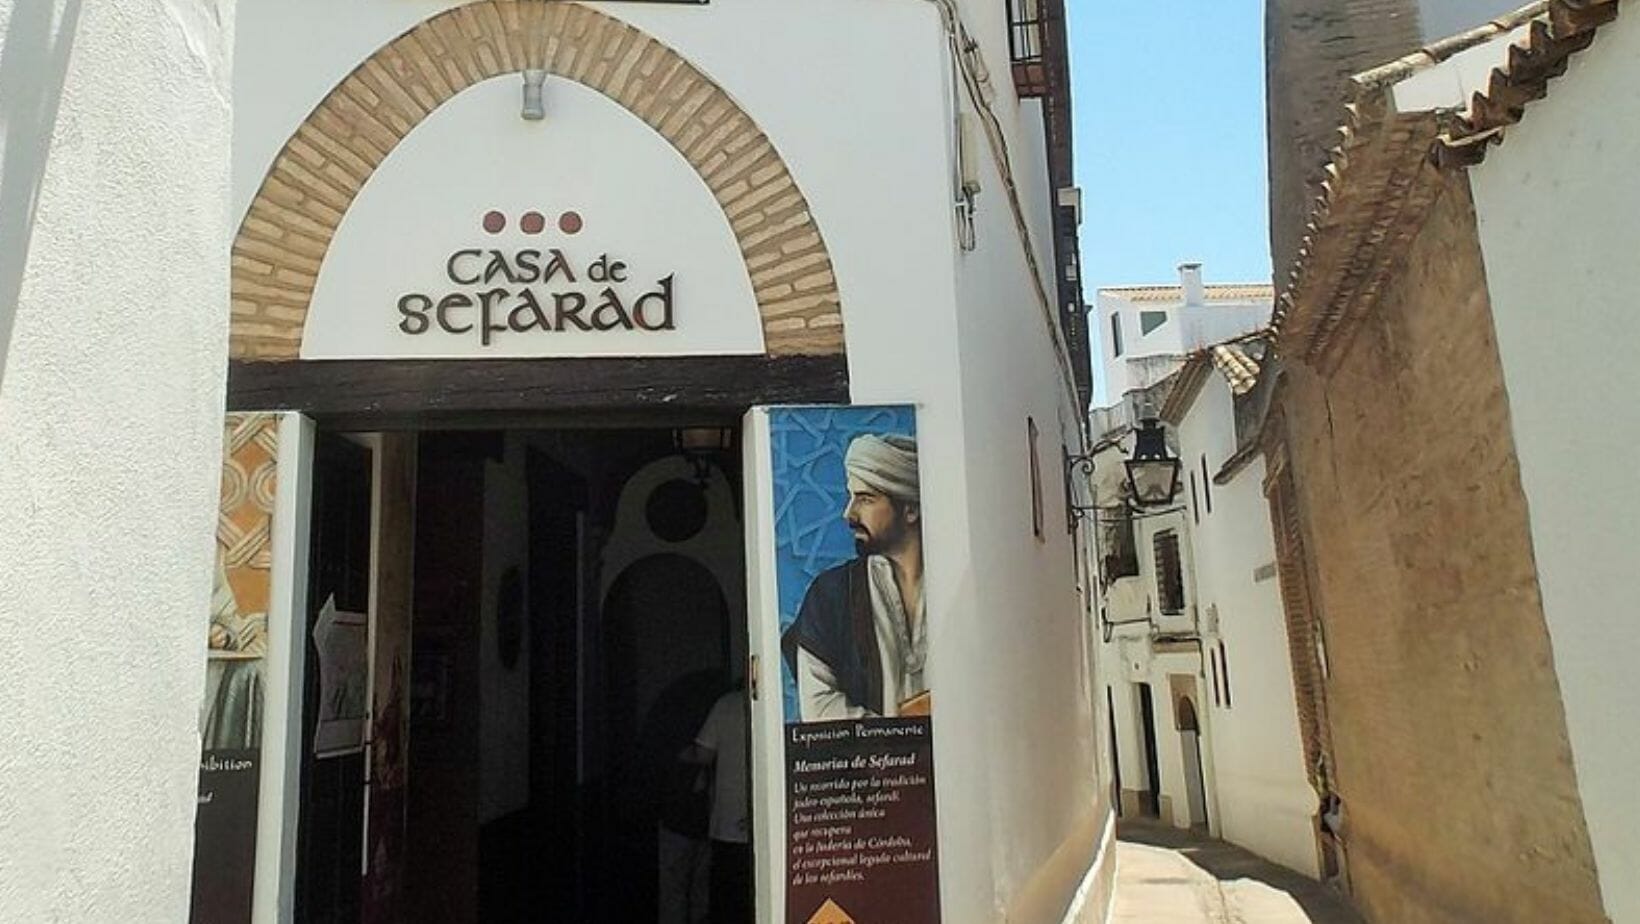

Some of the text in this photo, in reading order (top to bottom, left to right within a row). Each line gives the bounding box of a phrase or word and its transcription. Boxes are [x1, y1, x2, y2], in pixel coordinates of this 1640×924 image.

[447, 249, 628, 285] CASA de
[855, 723, 924, 737] Permanente
[793, 753, 916, 773] Memorias de Sefarad
[794, 781, 809, 793] Un
[851, 779, 869, 791] por
[869, 776, 881, 788] la
[794, 812, 812, 824] Una
[793, 830, 808, 842] que
[793, 845, 804, 854] en
[805, 841, 814, 853] la
[853, 838, 866, 849] de
[860, 852, 891, 868] legado
[893, 849, 931, 862] cultural
[793, 874, 804, 885] de
[805, 872, 818, 883] los
